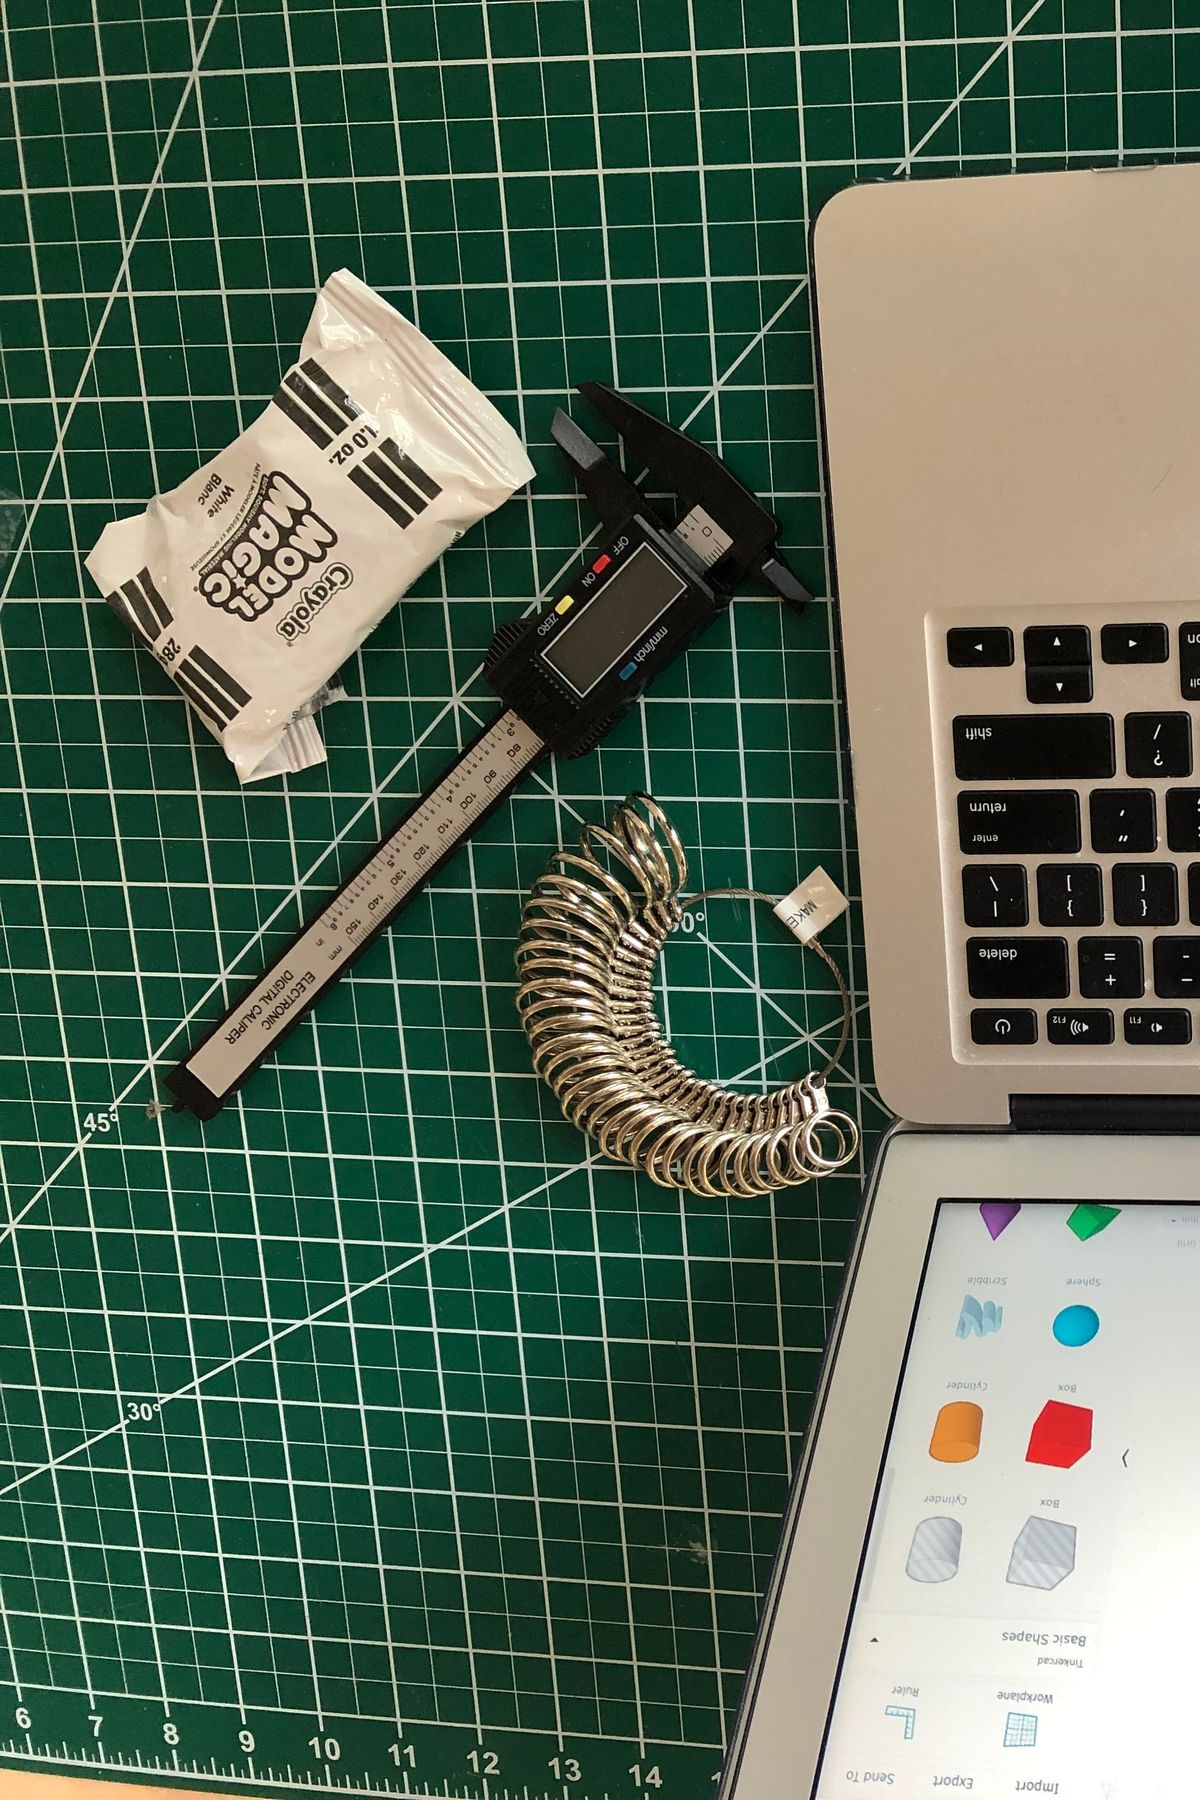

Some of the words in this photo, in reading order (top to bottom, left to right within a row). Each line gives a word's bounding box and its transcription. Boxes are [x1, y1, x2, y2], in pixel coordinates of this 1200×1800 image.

[328, 441, 355, 469] oz.
[195, 472, 223, 506] Blanc
[205, 483, 235, 519] White
[611, 535, 629, 554] OFF
[225, 511, 336, 625] MODEL
[581, 571, 596, 587] ON
[276, 560, 352, 642] Crayola
[536, 613, 558, 636] ZERO
[634, 625, 668, 663] mm/inch
[965, 727, 992, 741] shift
[482, 769, 496, 783] 90
[459, 791, 476, 809] 100
[969, 802, 1007, 814] return
[436, 817, 452, 834] 110
[972, 834, 999, 843] enter
[412, 842, 429, 860] 120
[389, 867, 406, 885] 130
[367, 892, 383, 910] 140
[785, 899, 816, 930] MAKE
[344, 918, 361, 935] 150
[315, 937, 324, 947] in
[328, 945, 342, 960] mm
[979, 948, 1018, 961] delete
[259, 970, 293, 1006] DIGITAL
[260, 971, 315, 1031] ELECTRONIC
[224, 1004, 262, 1044] CALIPER
[1052, 1015, 1066, 1024] F12
[1129, 1016, 1142, 1024] F11
[83, 1112, 118, 1132] 45°
[968, 1276, 1008, 1286] Scribble
[1066, 1276, 1102, 1287] Sphere
[946, 1380, 988, 1392] Cylinder
[1057, 1384, 1078, 1393] Box
[127, 1402, 160, 1421] 30°
[924, 1494, 968, 1505] Cylinder
[1040, 1498, 1060, 1509] Box
[1002, 1630, 1050, 1646] Shapes
[1052, 1634, 1087, 1648] Basic
[1036, 1656, 1084, 1668] Tinkercad
[891, 1685, 920, 1698] Ruler
[996, 1690, 1054, 1704] Workplane
[15, 1707, 32, 1729] 6
[88, 1715, 104, 1737] 7
[163, 1723, 180, 1745] 8
[238, 1730, 256, 1753] 9
[308, 1737, 341, 1761] 10
[388, 1743, 416, 1768] 11
[467, 1750, 500, 1775] 12
[548, 1757, 582, 1781] 13
[628, 1764, 663, 1788] 14
[846, 1770, 860, 1783] To
[864, 1770, 895, 1785] Send
[932, 1774, 974, 1790] Export
[1015, 1779, 1059, 1794] Import
